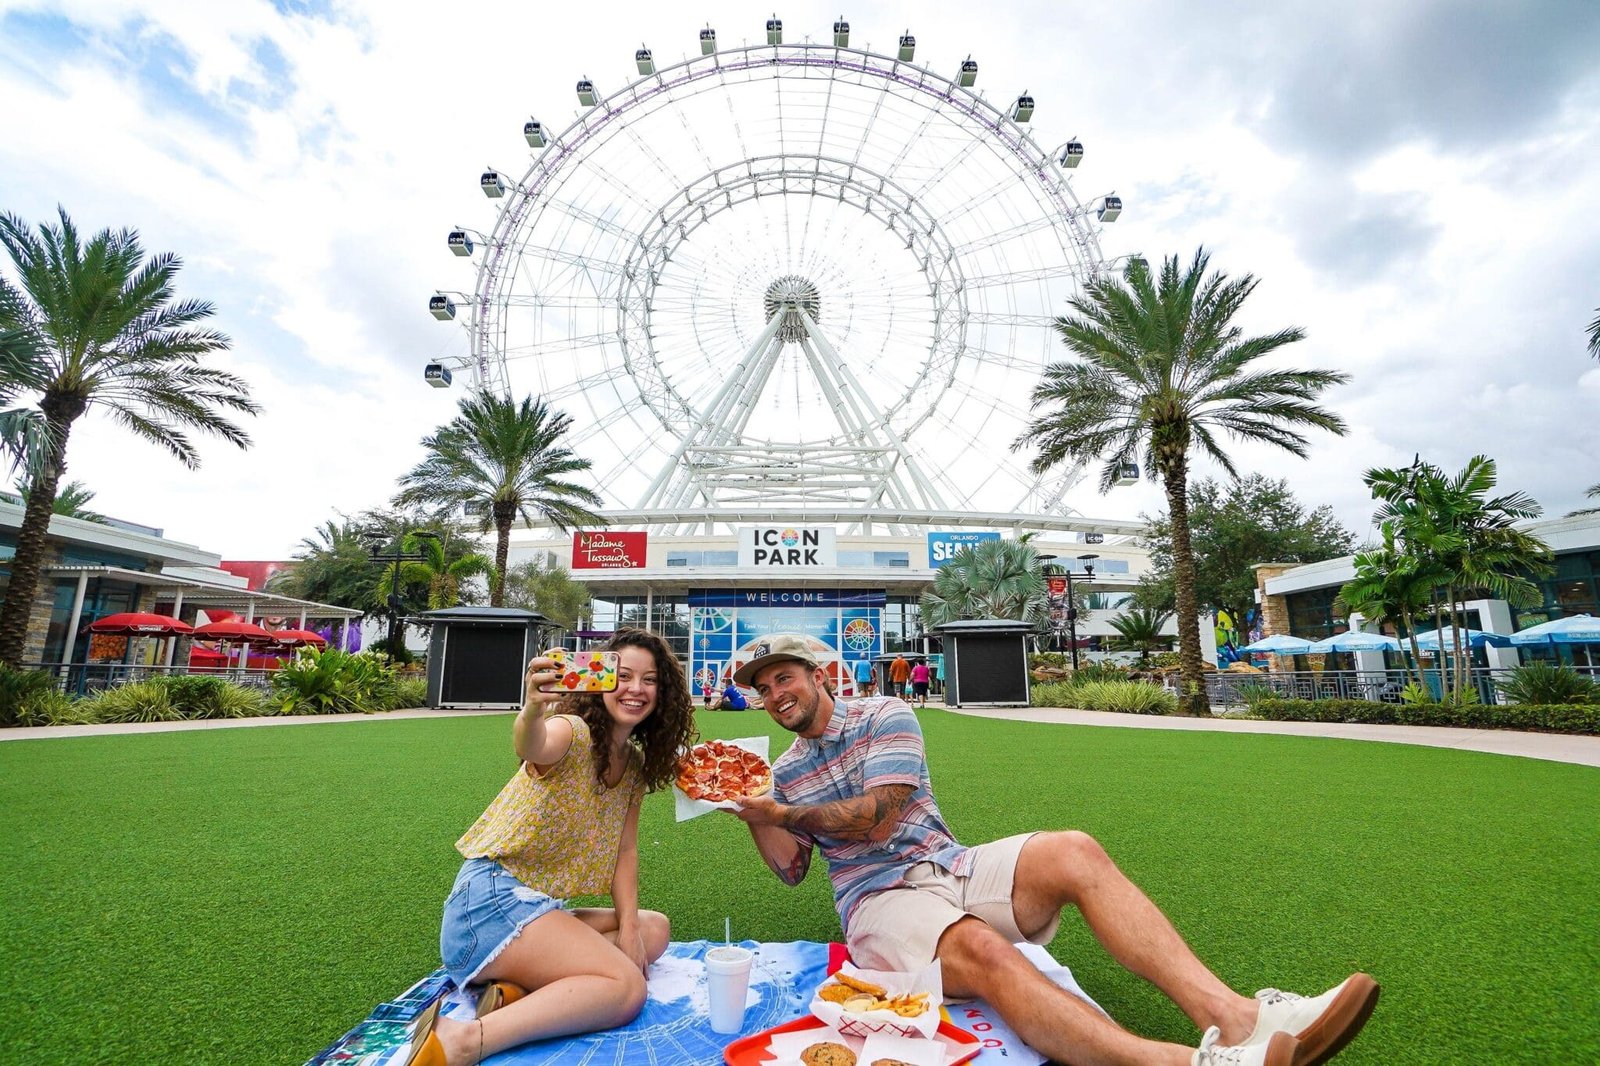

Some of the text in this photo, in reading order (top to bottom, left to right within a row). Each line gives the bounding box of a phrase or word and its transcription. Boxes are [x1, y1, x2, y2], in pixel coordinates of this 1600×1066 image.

[580, 534, 625, 549] Madame
[754, 528, 818, 546] ICON
[581, 548, 631, 567] Tussauds
[754, 549, 819, 565] PARK
[746, 593, 824, 602] WELCOME
